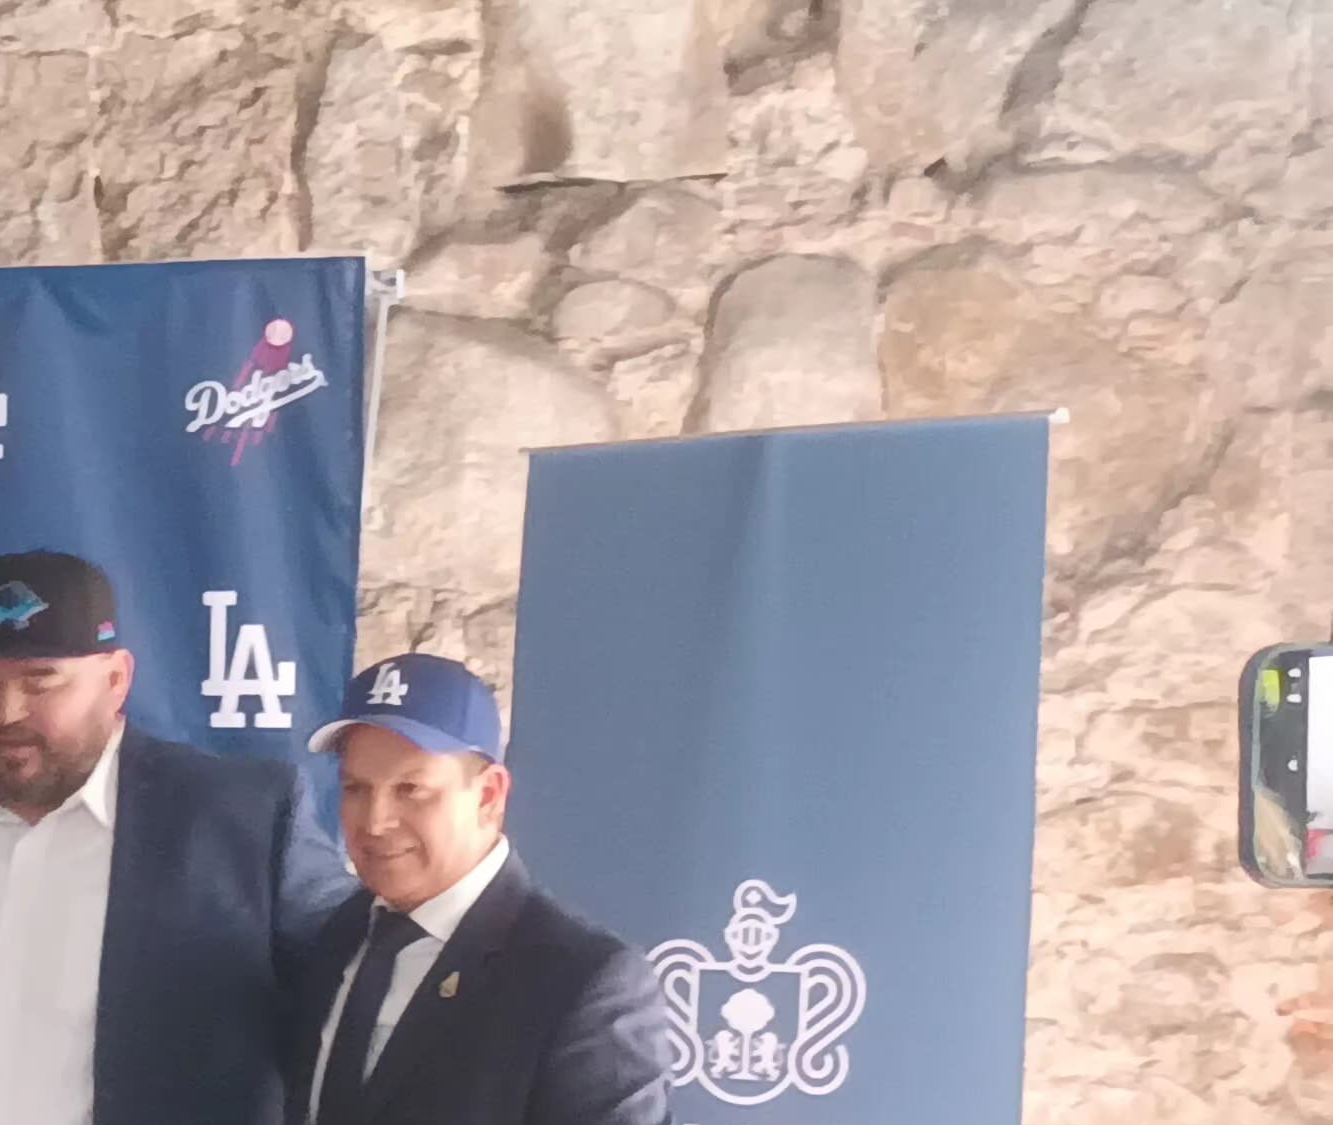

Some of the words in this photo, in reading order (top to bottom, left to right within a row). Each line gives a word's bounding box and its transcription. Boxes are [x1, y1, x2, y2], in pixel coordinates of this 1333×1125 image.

[184, 353, 329, 434] Dodgers
[201, 590, 296, 728] LA
[367, 662, 408, 706] LA
